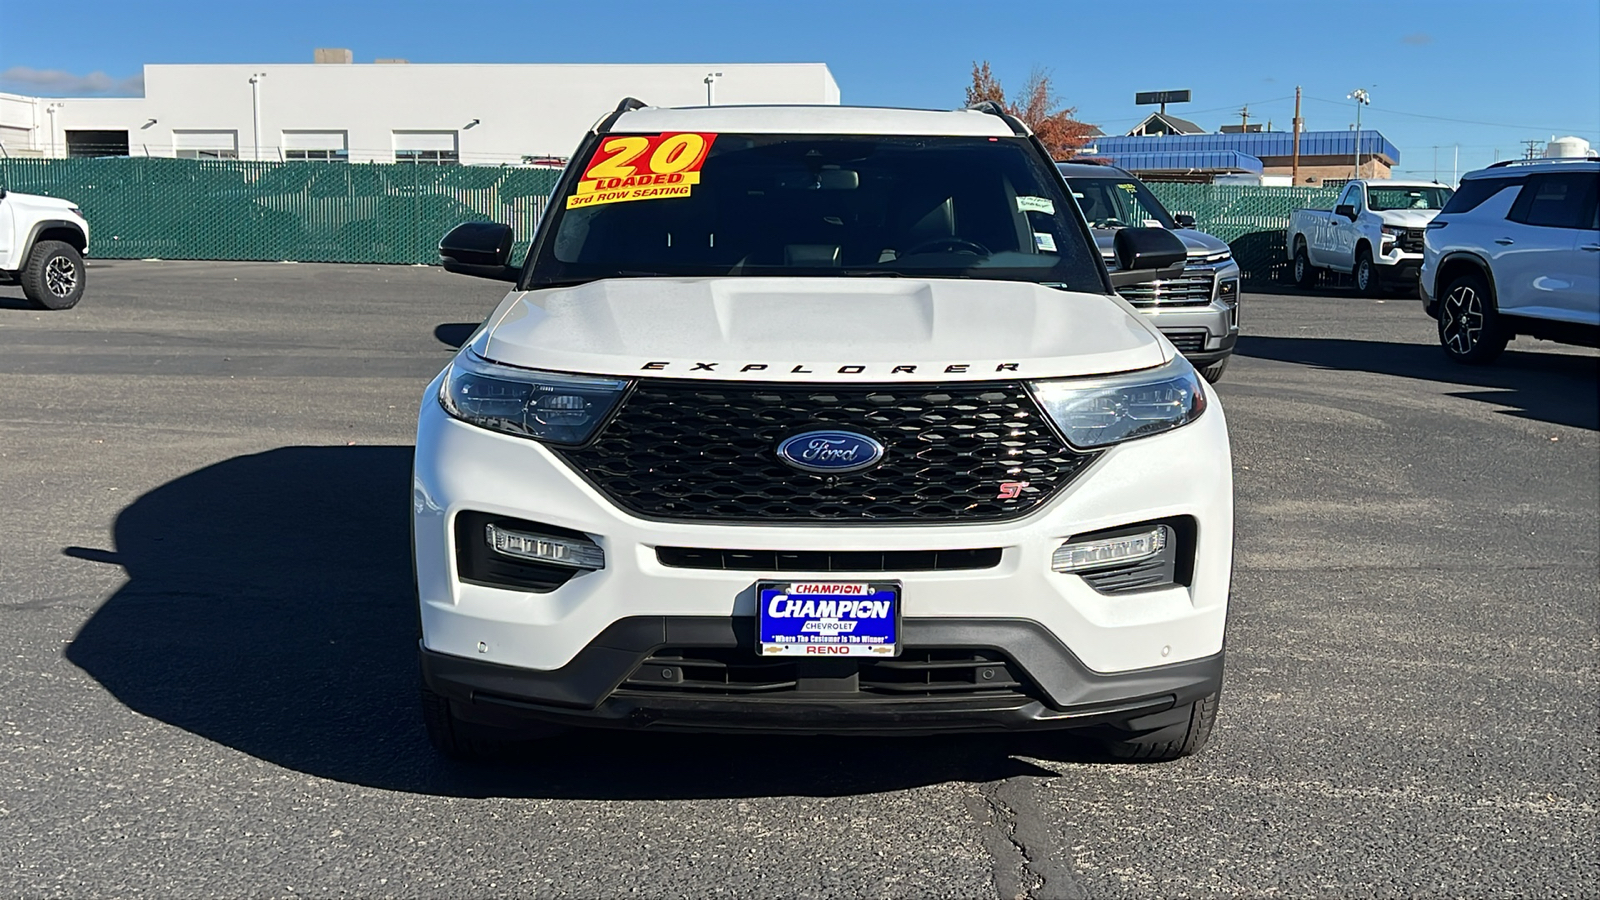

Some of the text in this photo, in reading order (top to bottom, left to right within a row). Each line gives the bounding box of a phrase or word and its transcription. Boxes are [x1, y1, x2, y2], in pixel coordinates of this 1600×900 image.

[586, 133, 707, 178] 20
[594, 172, 685, 191] LOADED
[570, 186, 689, 206] 3rd ROW SEATING
[641, 361, 1020, 374] EXPLORER
[802, 438, 860, 462] Ford
[997, 481, 1030, 499] ST
[796, 584, 862, 594] CHAMPION
[768, 595, 891, 618] CHAMPION
[805, 622, 853, 630] CHEVROLET
[797, 635, 809, 643] The
[810, 635, 841, 643] Customer
[806, 645, 850, 654] RENO
